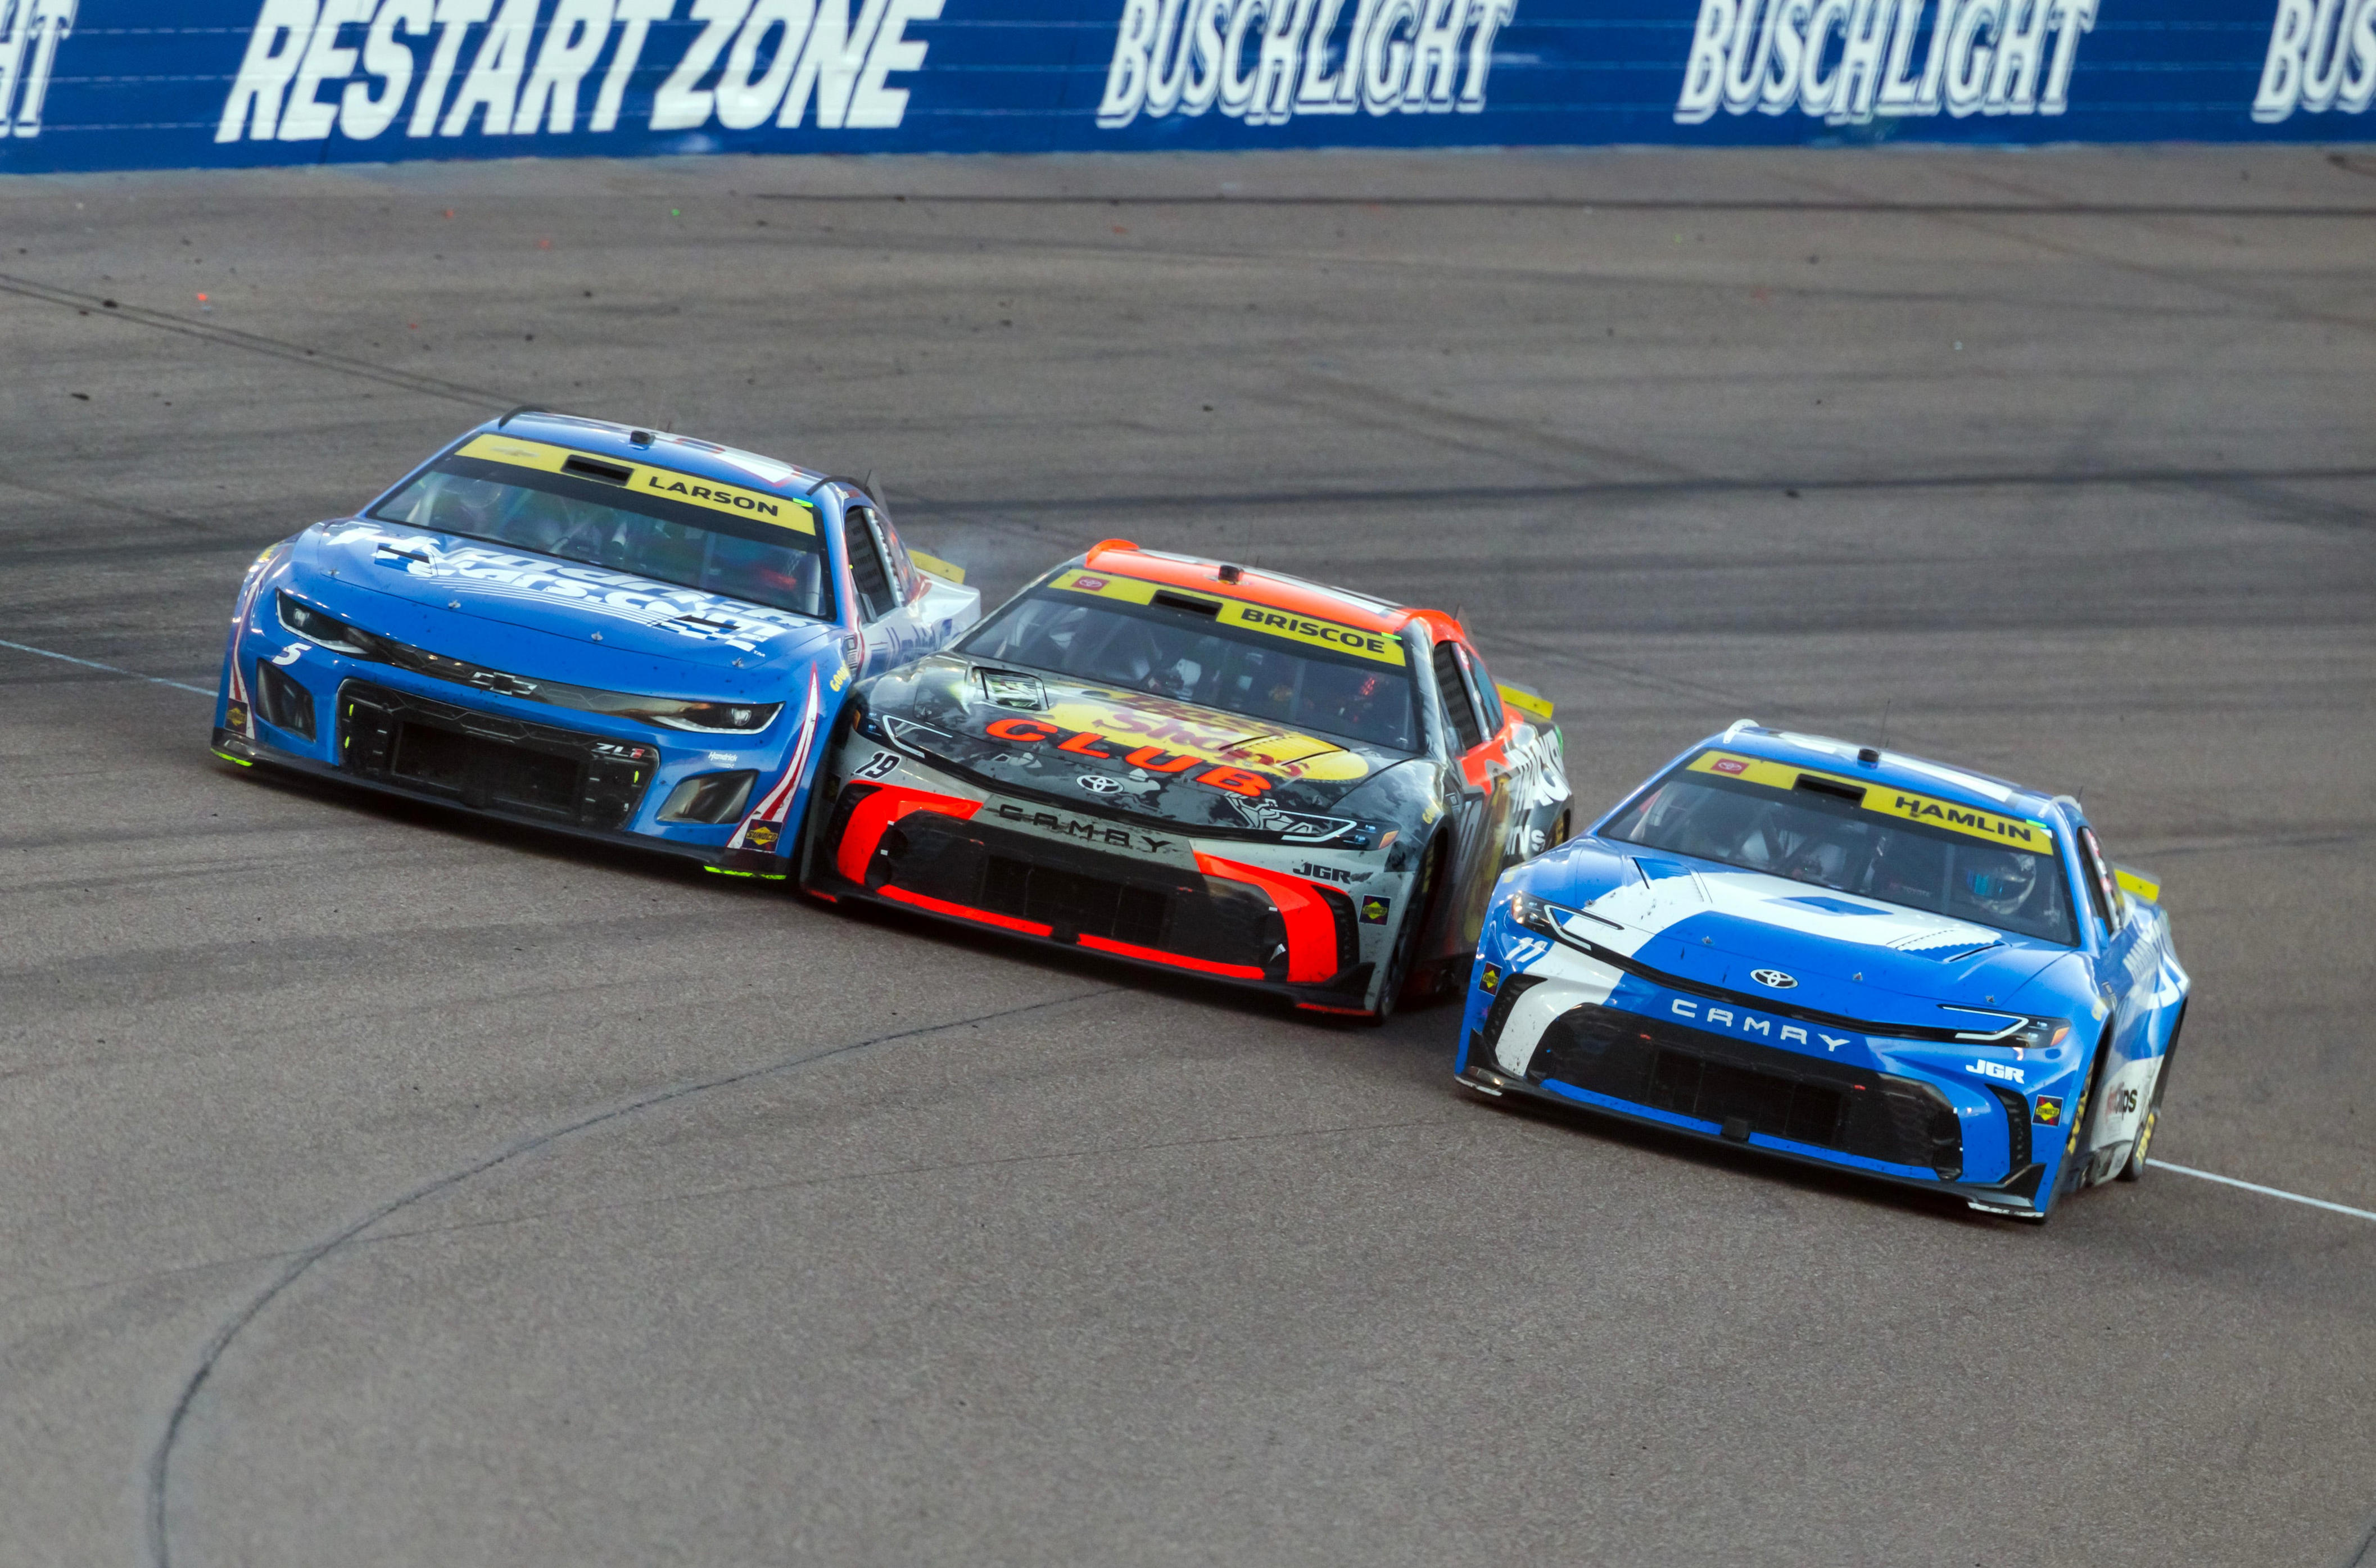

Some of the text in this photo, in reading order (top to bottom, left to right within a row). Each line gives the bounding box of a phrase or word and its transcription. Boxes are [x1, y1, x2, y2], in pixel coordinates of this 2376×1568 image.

[214, 0, 945, 143] RESTART ZONE
[649, 476, 779, 516] LARSON
[1241, 608, 1386, 654] BRISCOE
[271, 642, 312, 665] 5
[591, 742, 645, 759] ZL1
[854, 750, 902, 780] 19
[986, 718, 1271, 797] CLUB
[746, 830, 778, 842] SUNOCO
[999, 804, 1173, 853] CAMRY
[1895, 796, 2031, 842] HAMLIN
[1293, 861, 1351, 885] JGR
[1671, 998, 1850, 1053] CAMRY
[1966, 1059, 2025, 1084] JGR
